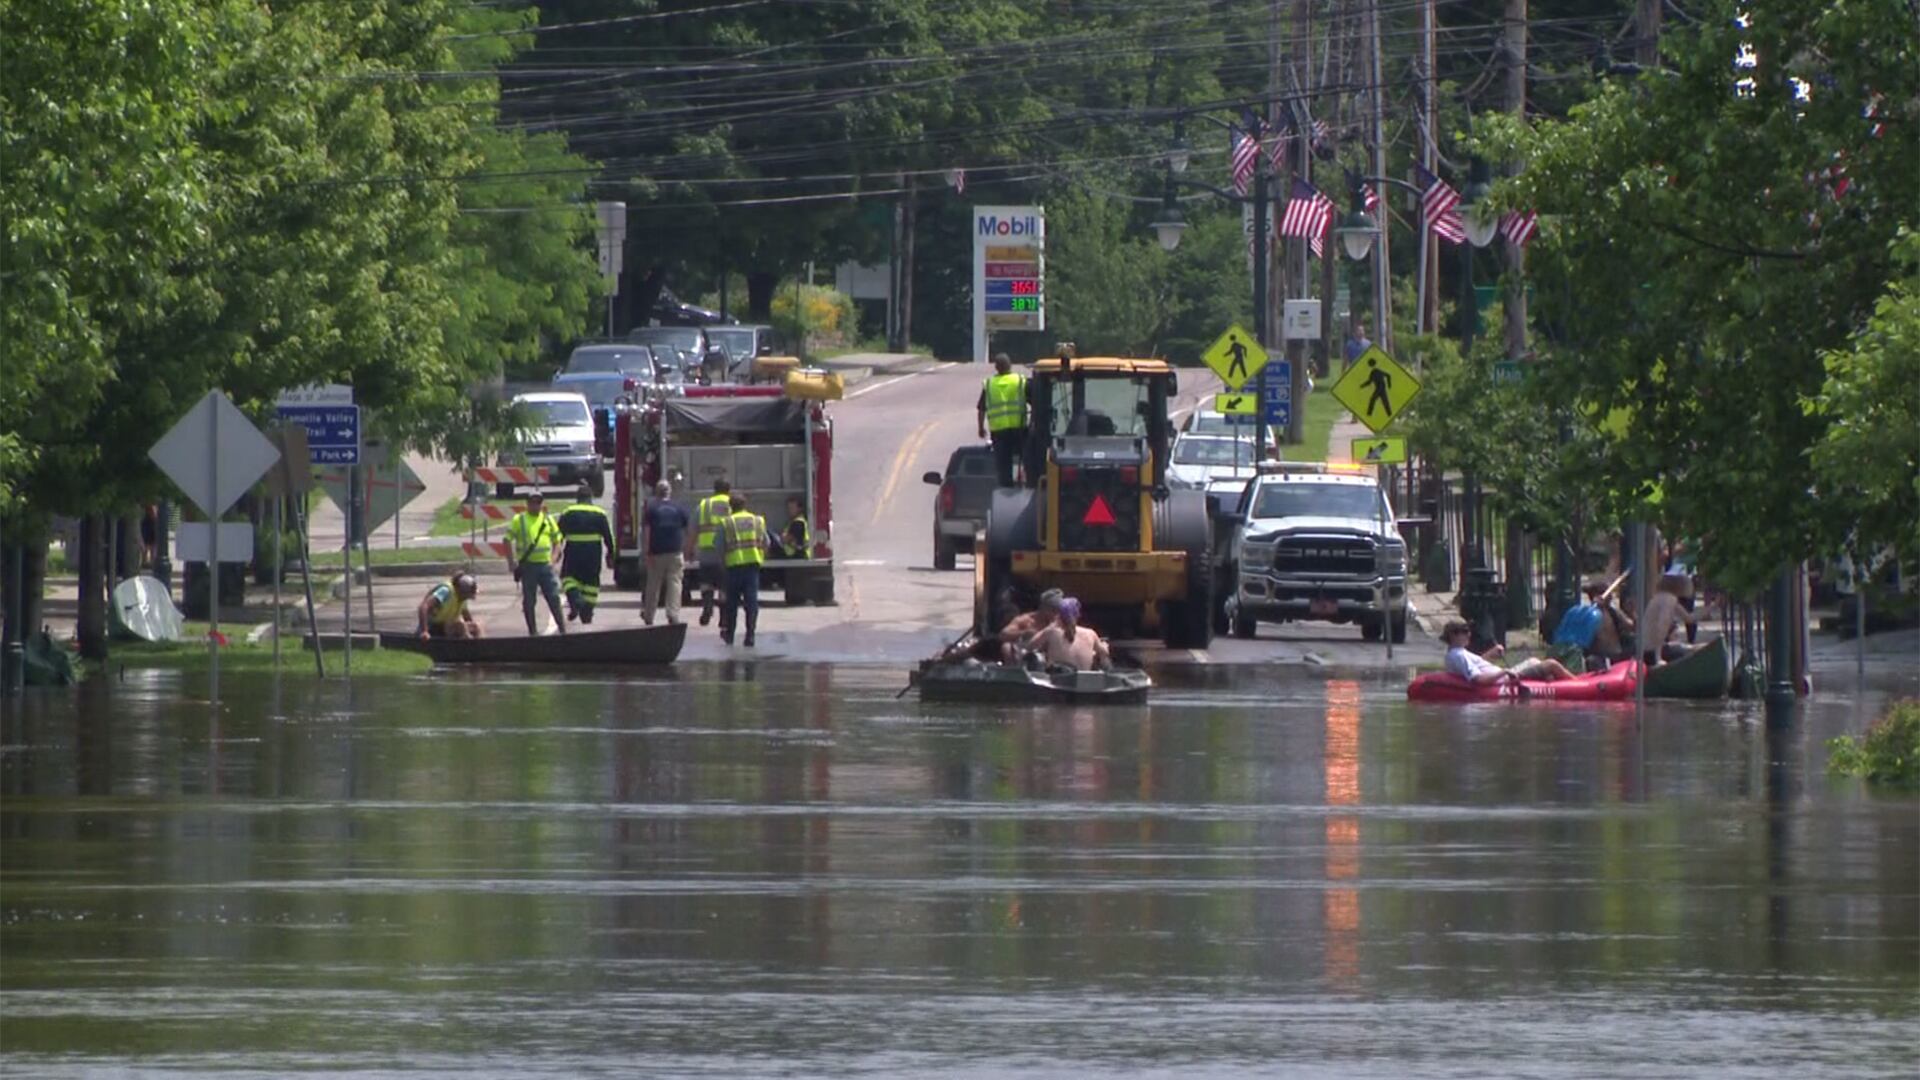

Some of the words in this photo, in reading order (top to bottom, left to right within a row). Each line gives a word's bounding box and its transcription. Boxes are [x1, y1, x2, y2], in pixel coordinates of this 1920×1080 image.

[979, 216, 1034, 236] Mobil
[325, 413, 355, 424] Valley
[1304, 549, 1346, 557] RAM
